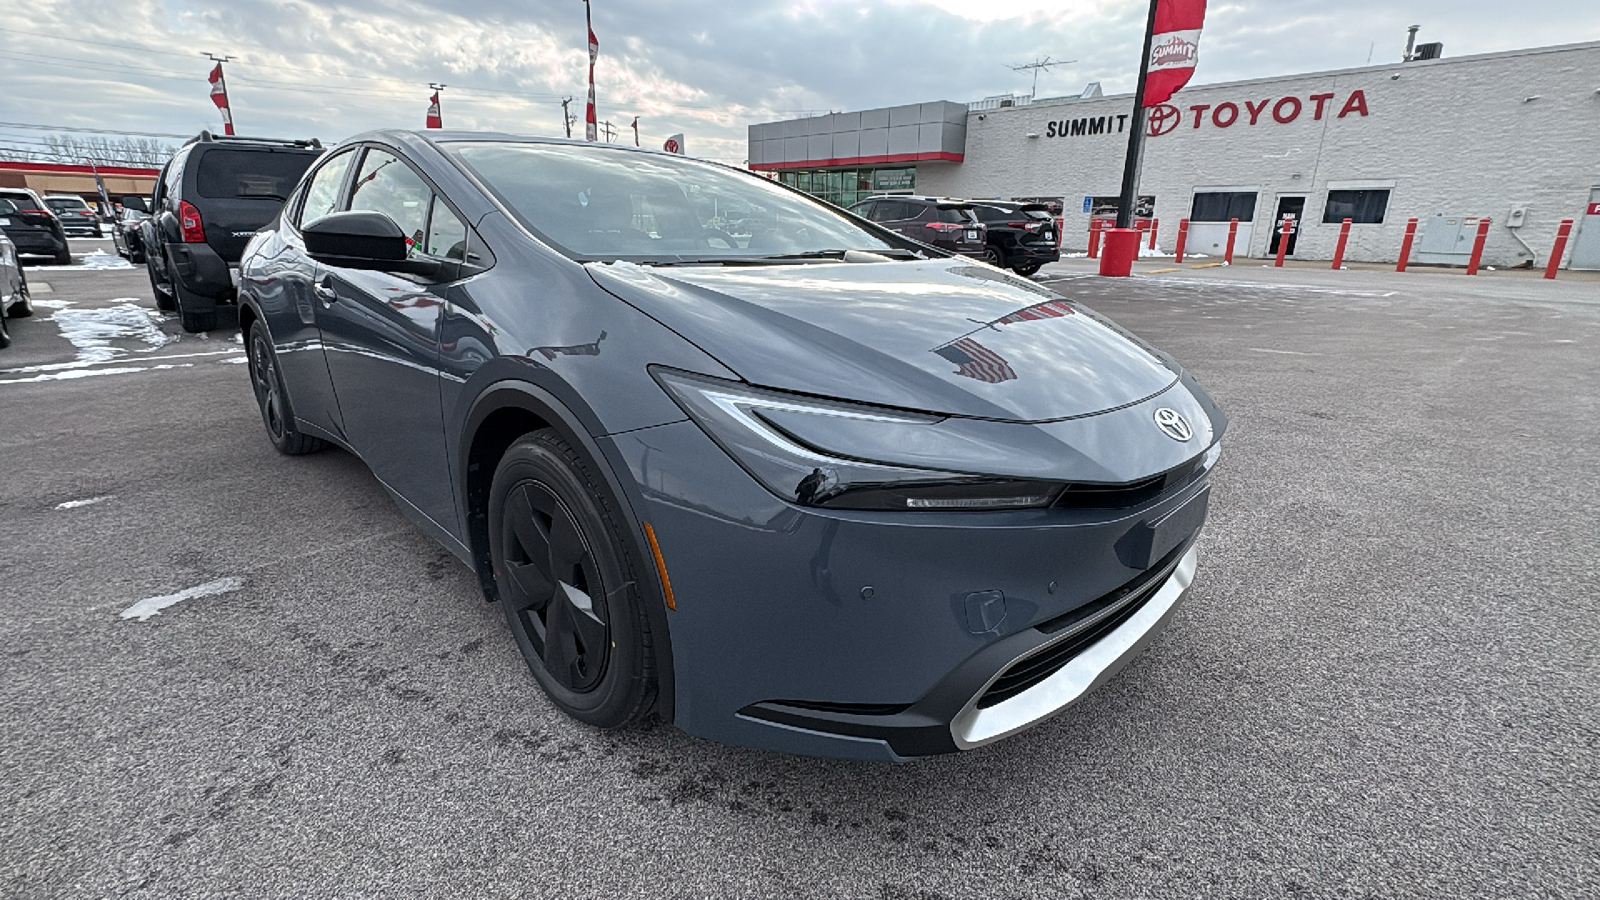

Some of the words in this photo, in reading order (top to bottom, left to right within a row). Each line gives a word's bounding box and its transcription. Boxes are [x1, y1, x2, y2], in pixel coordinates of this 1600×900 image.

[1152, 43, 1195, 65] SUMMIT
[1047, 114, 1128, 138] SUMMIT
[1189, 89, 1369, 129] TOYOTA
